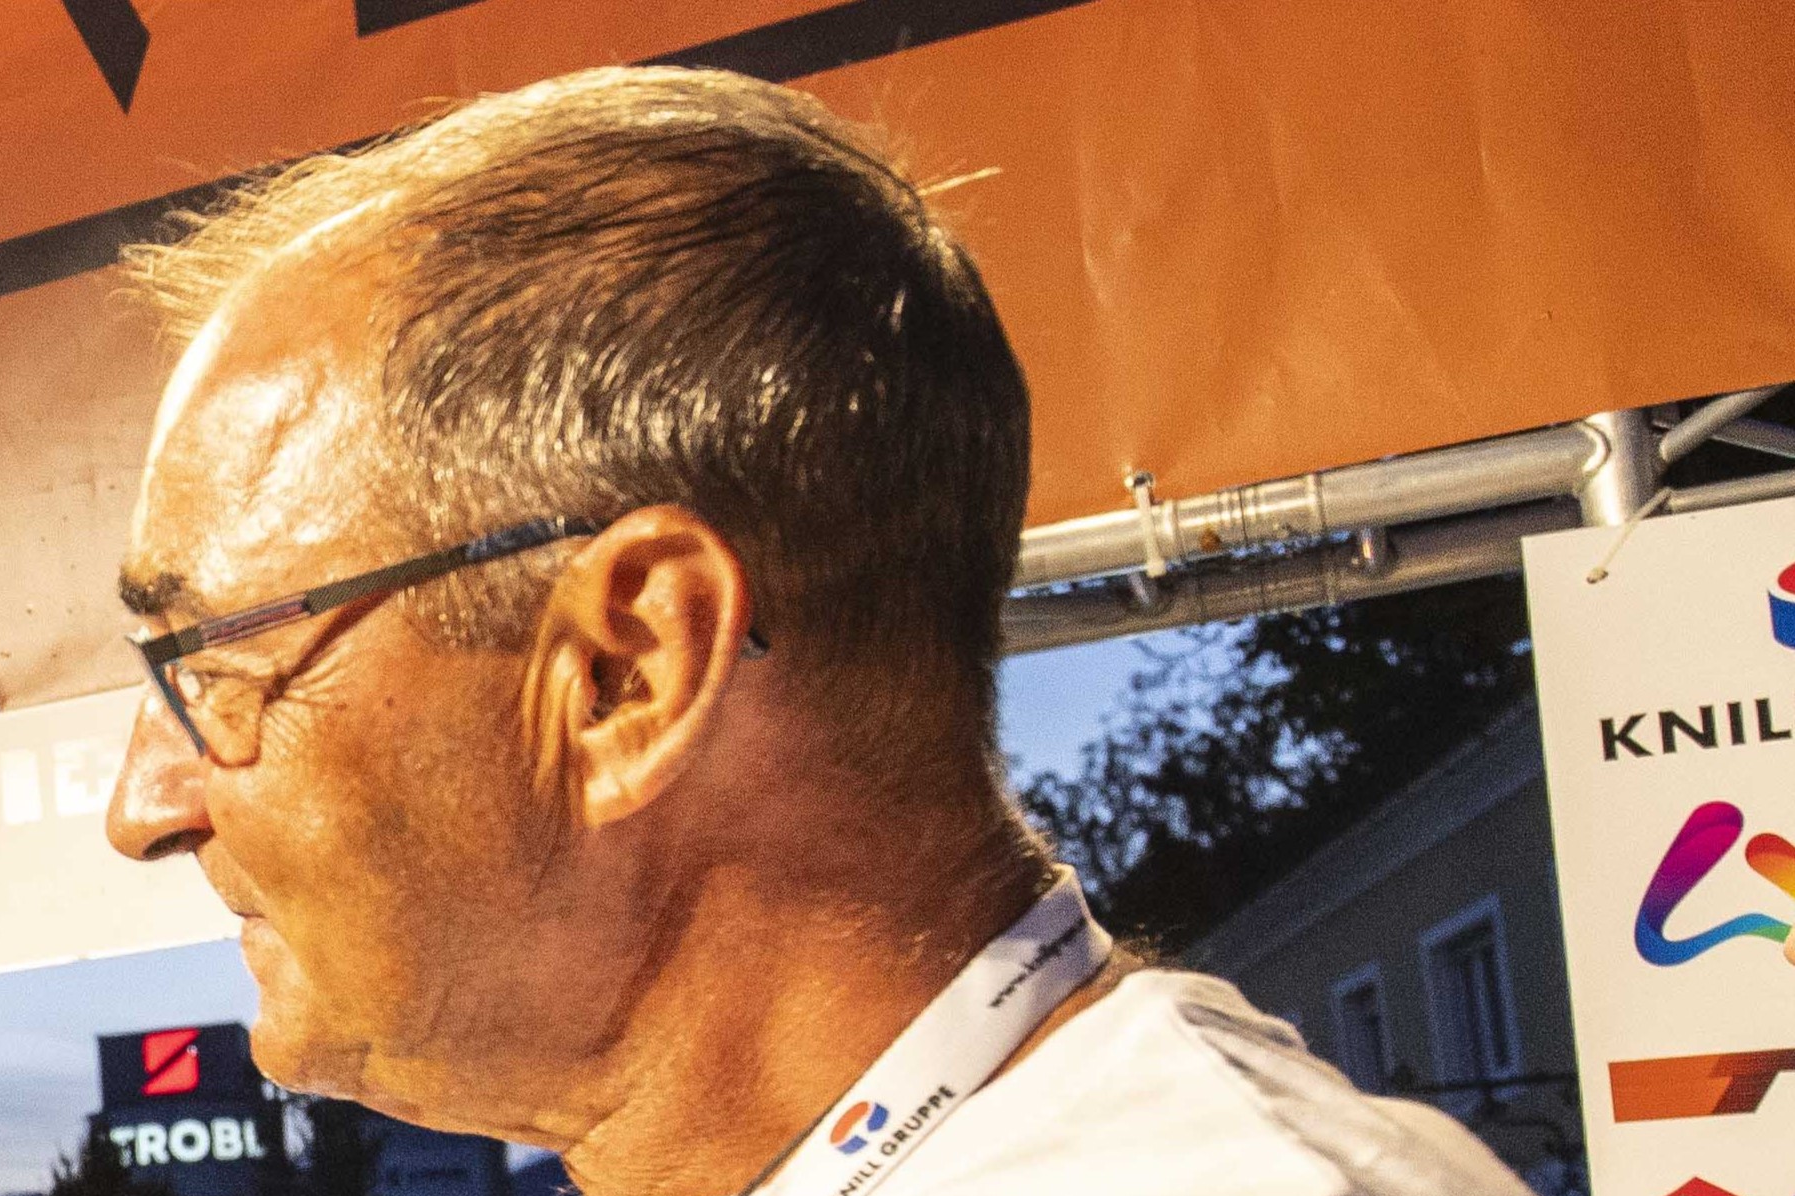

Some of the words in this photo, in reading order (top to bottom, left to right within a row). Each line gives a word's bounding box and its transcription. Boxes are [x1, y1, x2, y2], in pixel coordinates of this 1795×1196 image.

[1599, 697, 1793, 762] KNIL
[108, 1116, 266, 1168] TROBL
[879, 1085, 957, 1157] GRUPPE
